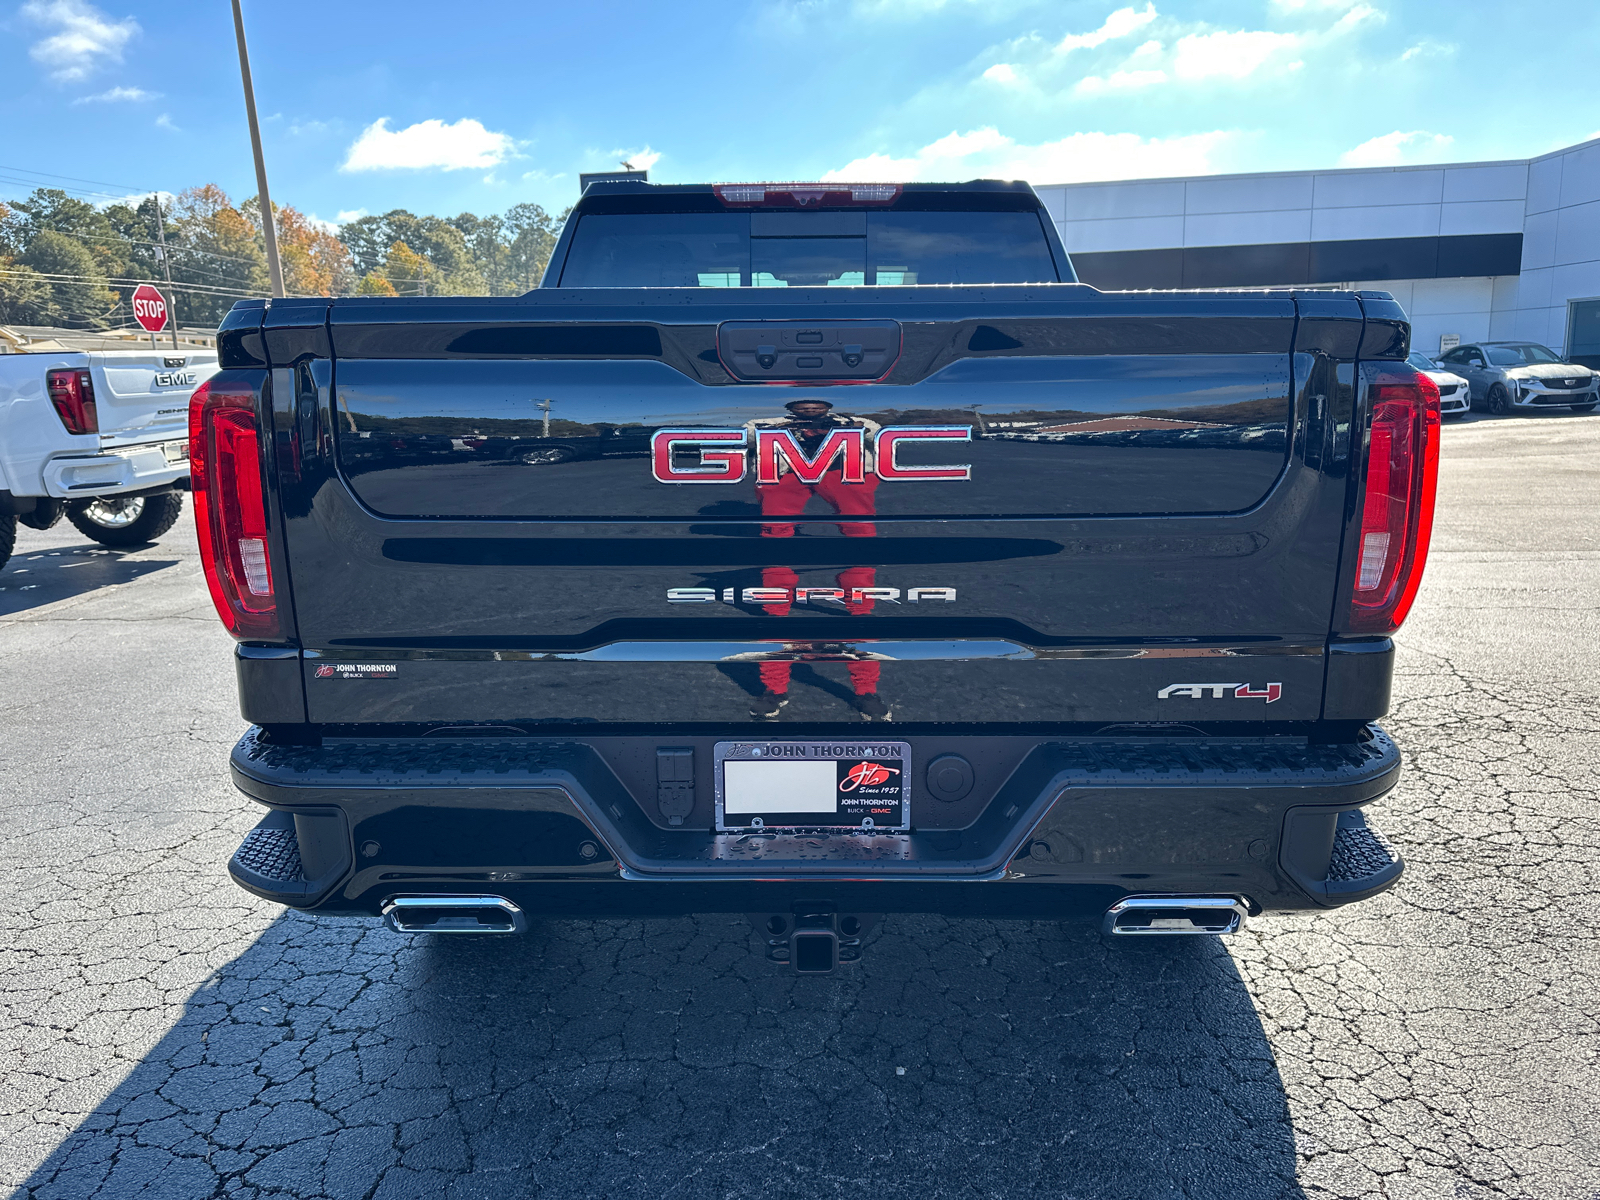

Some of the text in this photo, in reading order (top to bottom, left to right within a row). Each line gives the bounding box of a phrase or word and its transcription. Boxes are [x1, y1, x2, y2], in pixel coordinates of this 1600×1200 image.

[135, 299, 164, 318] STOP
[155, 373, 197, 387] GMC
[651, 425, 972, 485] GMC
[666, 587, 957, 605] SIERRA
[336, 664, 356, 672] JOHN
[356, 664, 396, 672] THORNTON
[1157, 682, 1282, 704] AT4
[763, 745, 806, 757] JOHN
[811, 745, 901, 757] THORNTON
